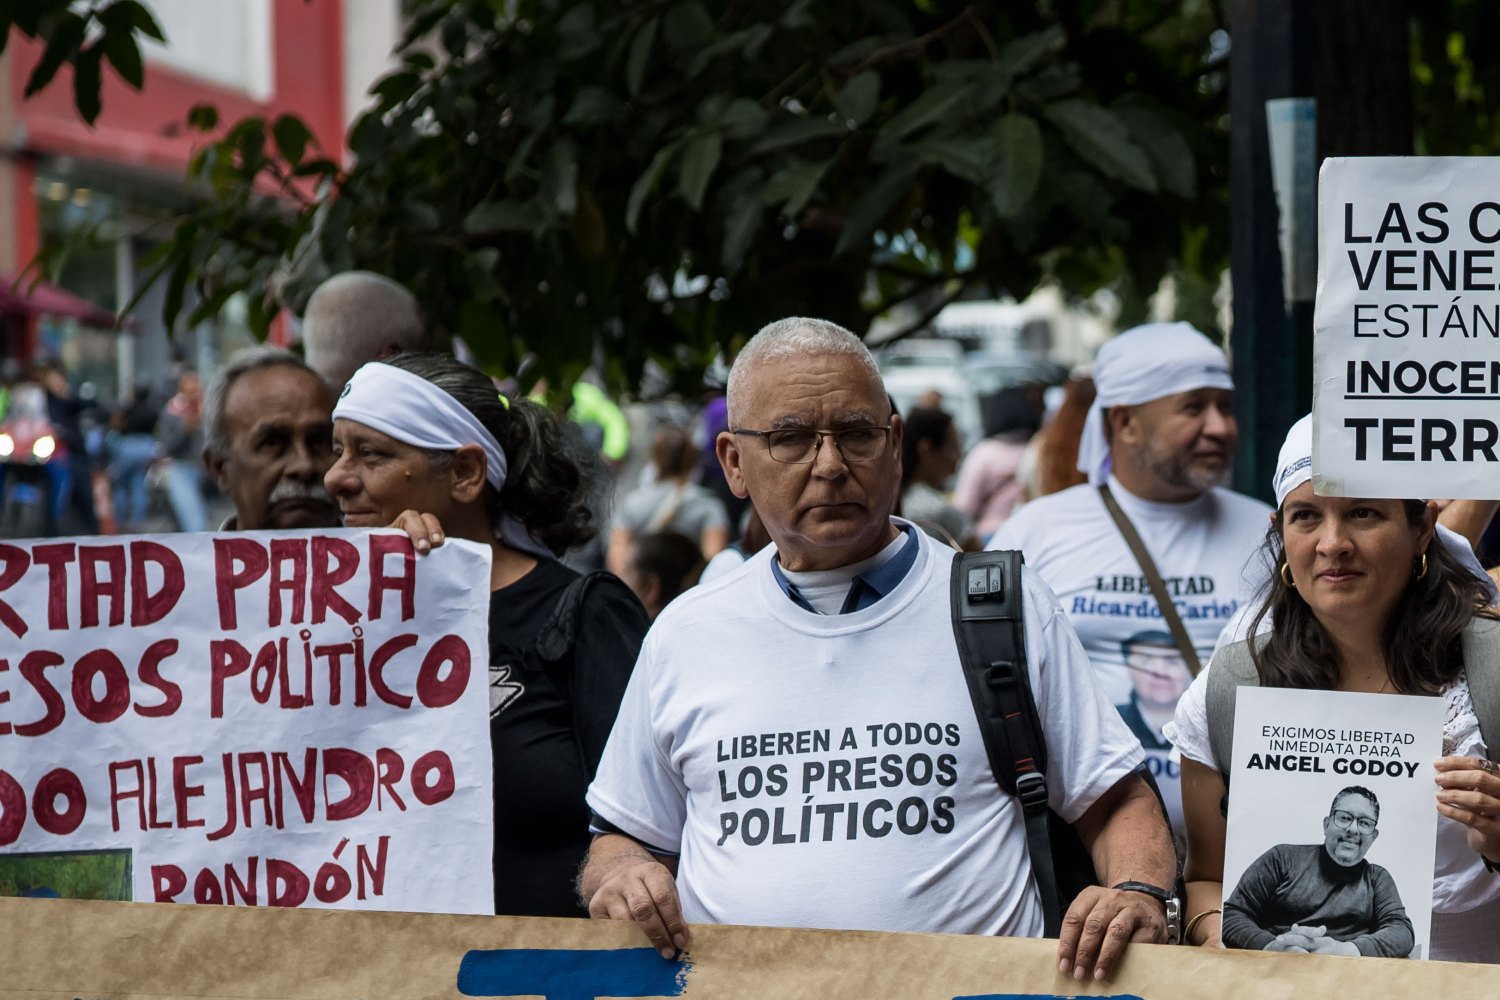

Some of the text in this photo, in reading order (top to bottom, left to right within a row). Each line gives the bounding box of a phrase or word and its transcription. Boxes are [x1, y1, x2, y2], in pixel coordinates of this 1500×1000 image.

[1344, 201, 1450, 244] LAS
[1353, 296, 1500, 339] ESTÁN
[213, 535, 417, 631] PARA
[1096, 575, 1216, 596] LIBETAD
[1071, 596, 1163, 619] Ricardo
[0, 637, 183, 738] SOS
[717, 722, 961, 763] LIBEREN A TODOS
[1262, 726, 1415, 745] EXIGIMOS LIBERTAD
[1269, 740, 1401, 758] INMEDIATA PARA
[718, 753, 959, 802] LOS PRESOS
[1246, 753, 1420, 779] ANGEL GODOY
[109, 748, 456, 842] ALEJANDRO
[717, 795, 956, 847] POLÍTICOS
[151, 835, 391, 908] RONDÓN
